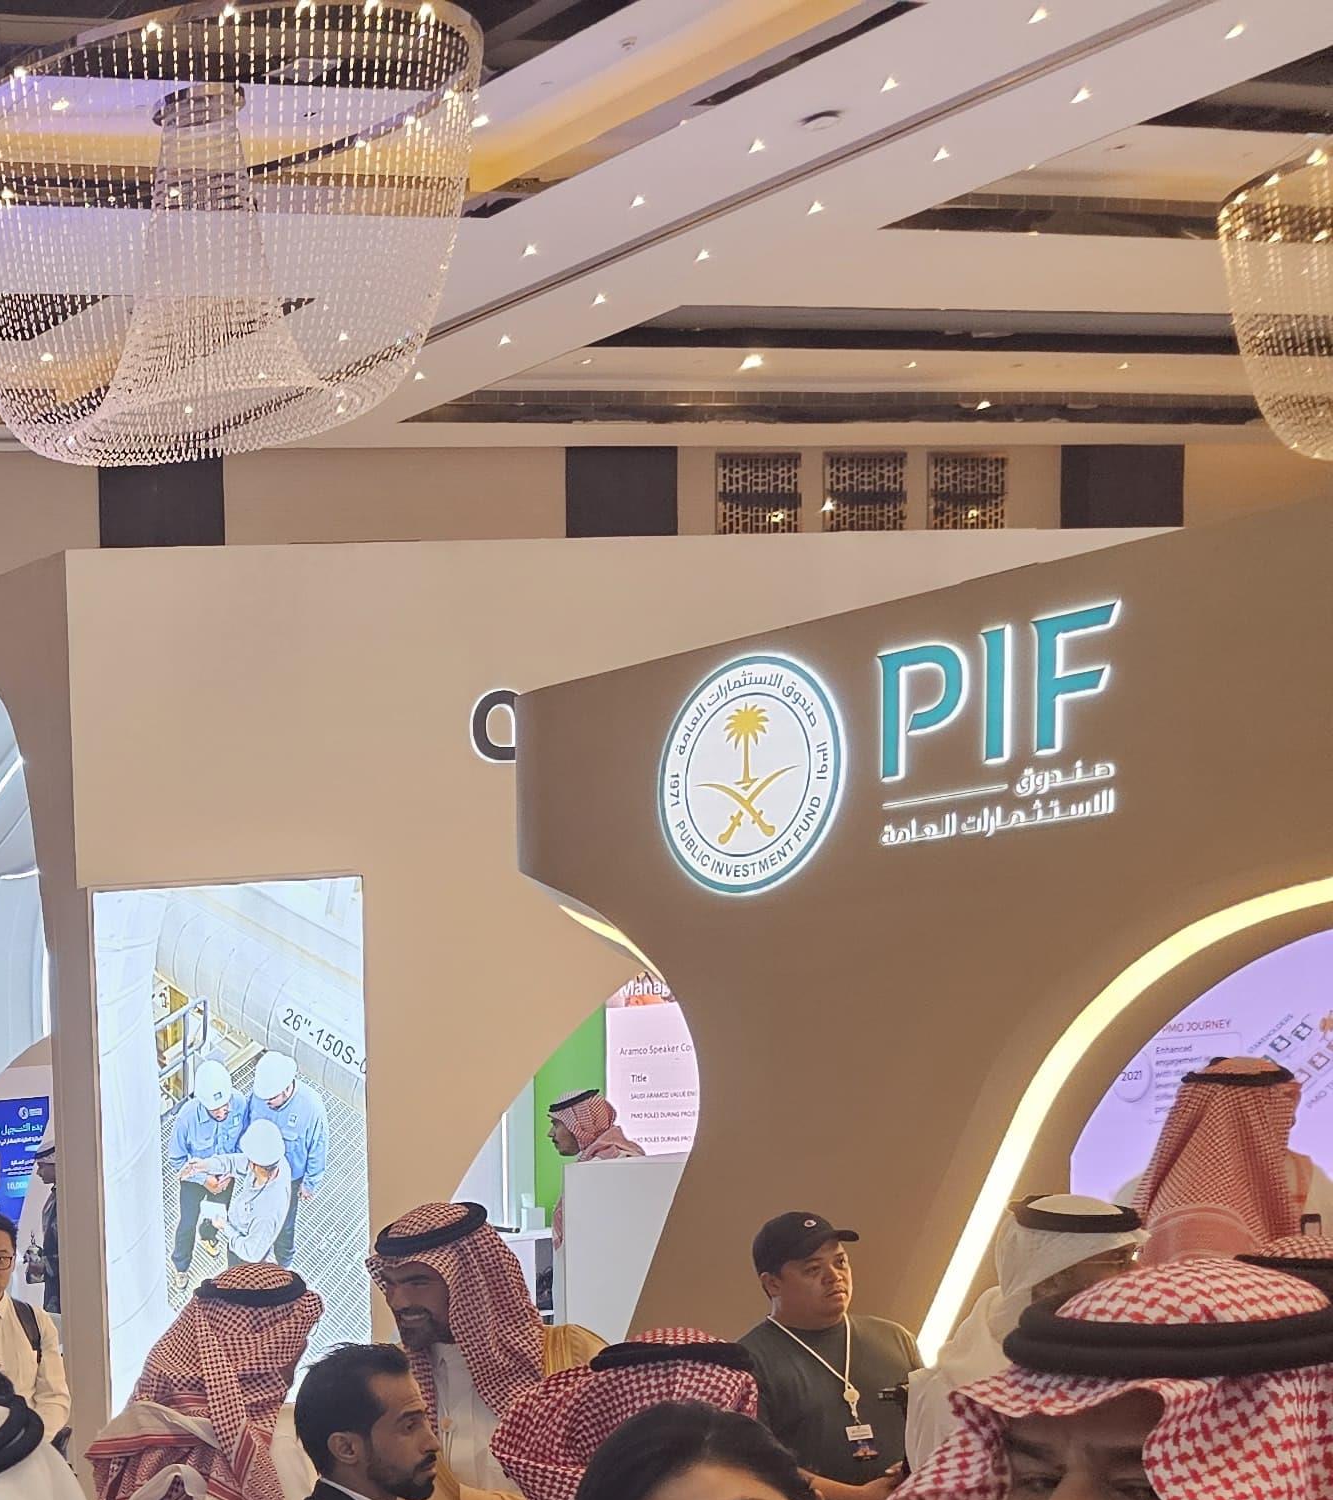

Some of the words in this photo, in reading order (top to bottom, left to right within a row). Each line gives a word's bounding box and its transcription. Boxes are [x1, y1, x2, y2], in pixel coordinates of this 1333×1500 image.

[707, 670, 783, 707] الاستثمارات
[783, 681, 817, 727] صندوق
[877, 601, 1120, 781] PIF
[675, 702, 708, 756] العامة
[670, 772, 681, 807] 1971
[1015, 760, 1116, 797] صندوق
[881, 813, 957, 845] العامة
[961, 788, 1115, 837] الاستثمارات
[675, 820, 711, 868] PUBLIC
[710, 839, 796, 878] INVESTMENT
[793, 796, 821, 843] FUND
[1187, 1018, 1231, 1031] JOURNEY
[620, 1047, 648, 1056] Aramco
[649, 1044, 679, 1055] Speaker
[631, 1074, 647, 1083] Title
[1121, 1070, 1142, 1081] 2021
